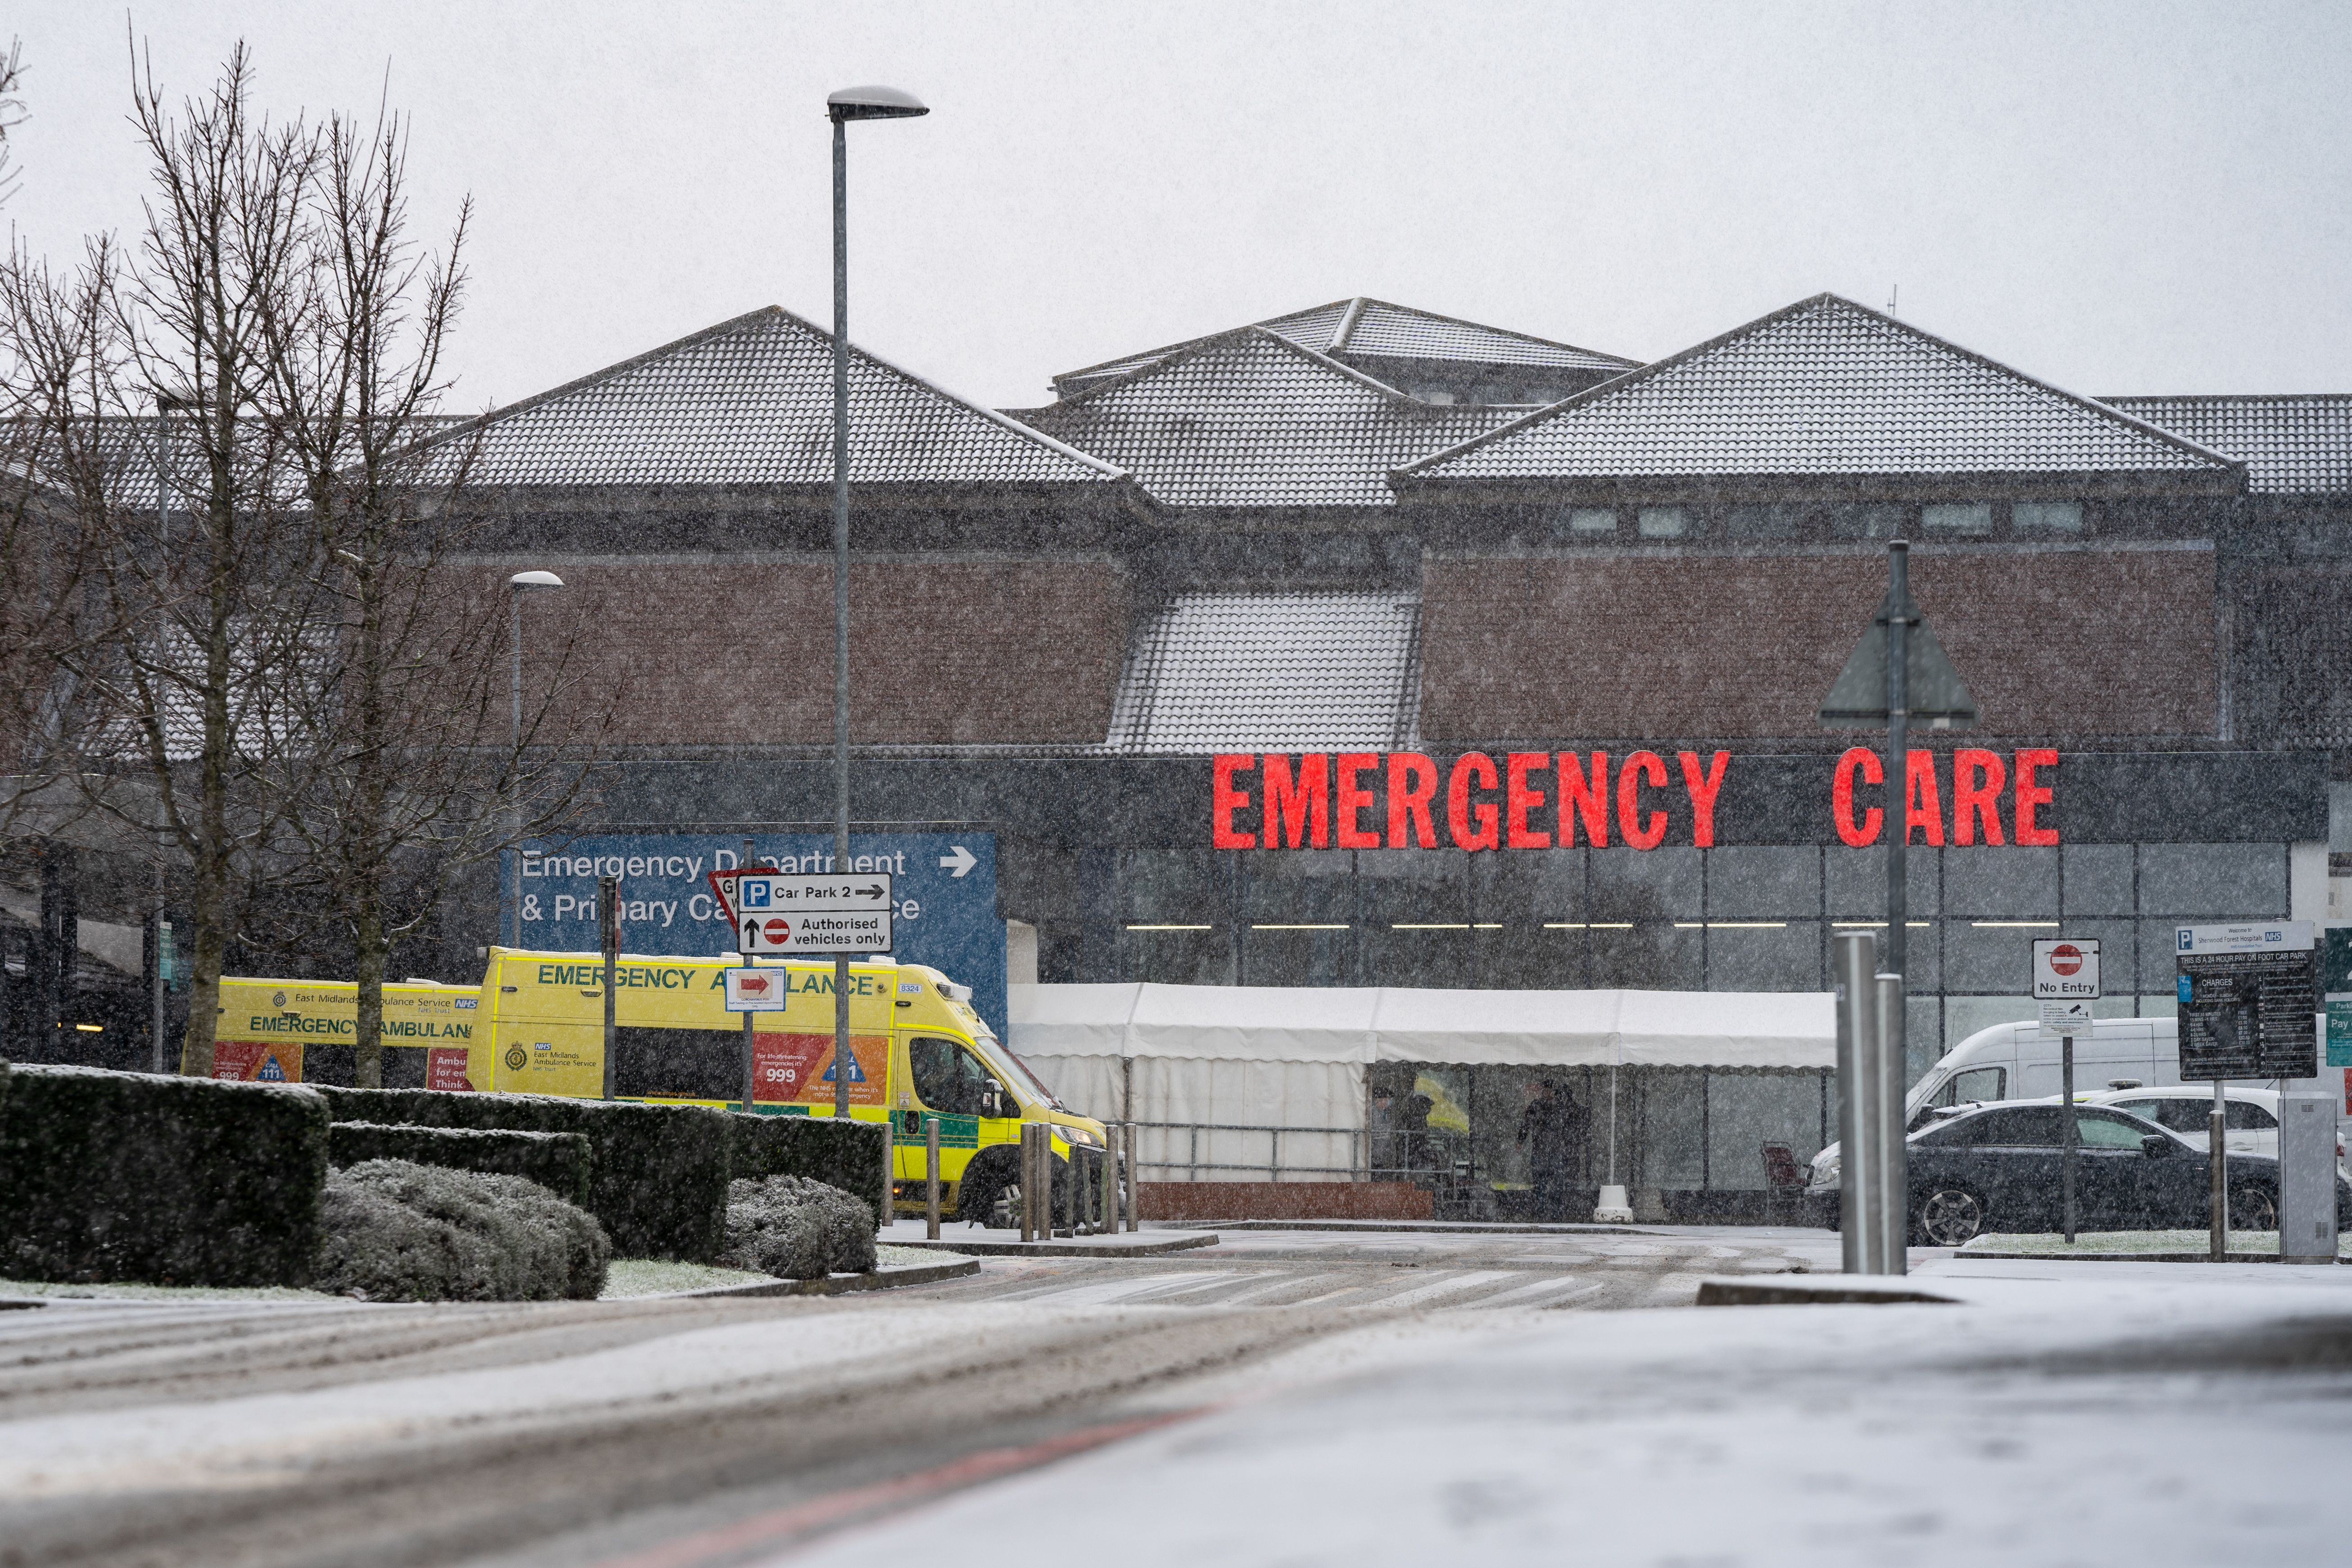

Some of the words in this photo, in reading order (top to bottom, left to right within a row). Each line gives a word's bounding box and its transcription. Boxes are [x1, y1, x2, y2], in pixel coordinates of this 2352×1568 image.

[1212, 750, 1731, 852] EMERGENCY
[1833, 747, 2059, 847] CARE
[522, 850, 703, 883] Emergency
[715, 849, 906, 875] Dartent
[750, 884, 766, 904] P
[775, 887, 799, 898] Car
[806, 886, 838, 898] Park
[842, 886, 851, 898] 2
[521, 893, 544, 921] &
[555, 894, 678, 928] Priary
[801, 918, 878, 930] Authorised
[794, 933, 851, 945] vehicles
[856, 932, 885, 946] only
[2181, 932, 2191, 949] P
[2266, 932, 2281, 941] NHS
[538, 965, 696, 989] EMERGENCY
[710, 971, 873, 996] ALANCE
[2202, 978, 2233, 986] CHARGES
[2040, 983, 2057, 992] No
[2062, 983, 2095, 994] Entry
[295, 993, 314, 1002] East
[318, 994, 359, 1004] Midlands
[381, 997, 414, 1006] ulance
[418, 998, 451, 1007] Service
[455, 999, 478, 1008] NHS
[380, 1021, 473, 1038] AMBULAN
[2331, 1019, 2349, 1030] Pay
[219, 1071, 239, 1081] 999
[263, 1069, 280, 1079] 111
[436, 1068, 450, 1076] for
[766, 1068, 796, 1082] 999
[831, 1065, 856, 1079] 11
[436, 1079, 463, 1088] Think
